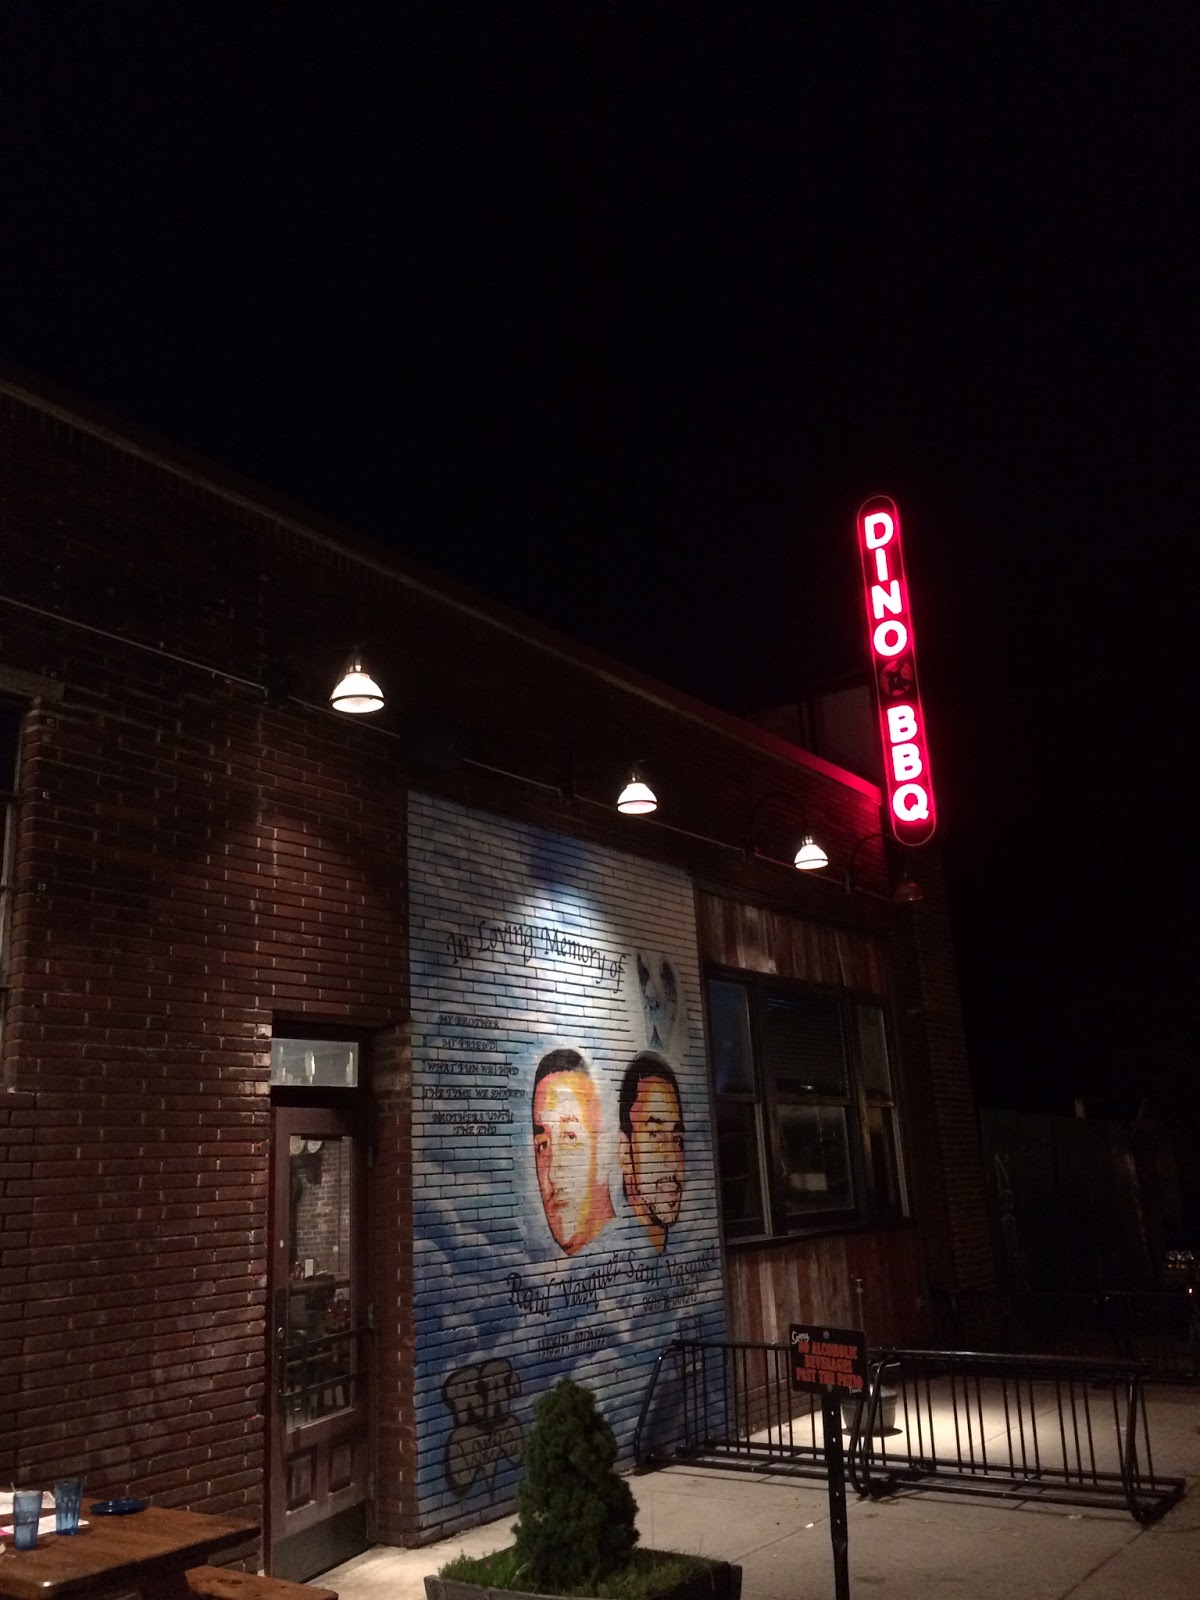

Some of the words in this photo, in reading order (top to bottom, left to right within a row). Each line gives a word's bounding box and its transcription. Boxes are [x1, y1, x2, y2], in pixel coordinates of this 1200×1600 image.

[864, 512, 907, 656] DINO
[887, 705, 929, 822] BBQ
[446, 933, 471, 965] In
[477, 920, 534, 962] Loving
[541, 926, 606, 984] Memory
[609, 954, 626, 994] of
[455, 1015, 500, 1028] BROTHER
[458, 1039, 496, 1050] FRIEND
